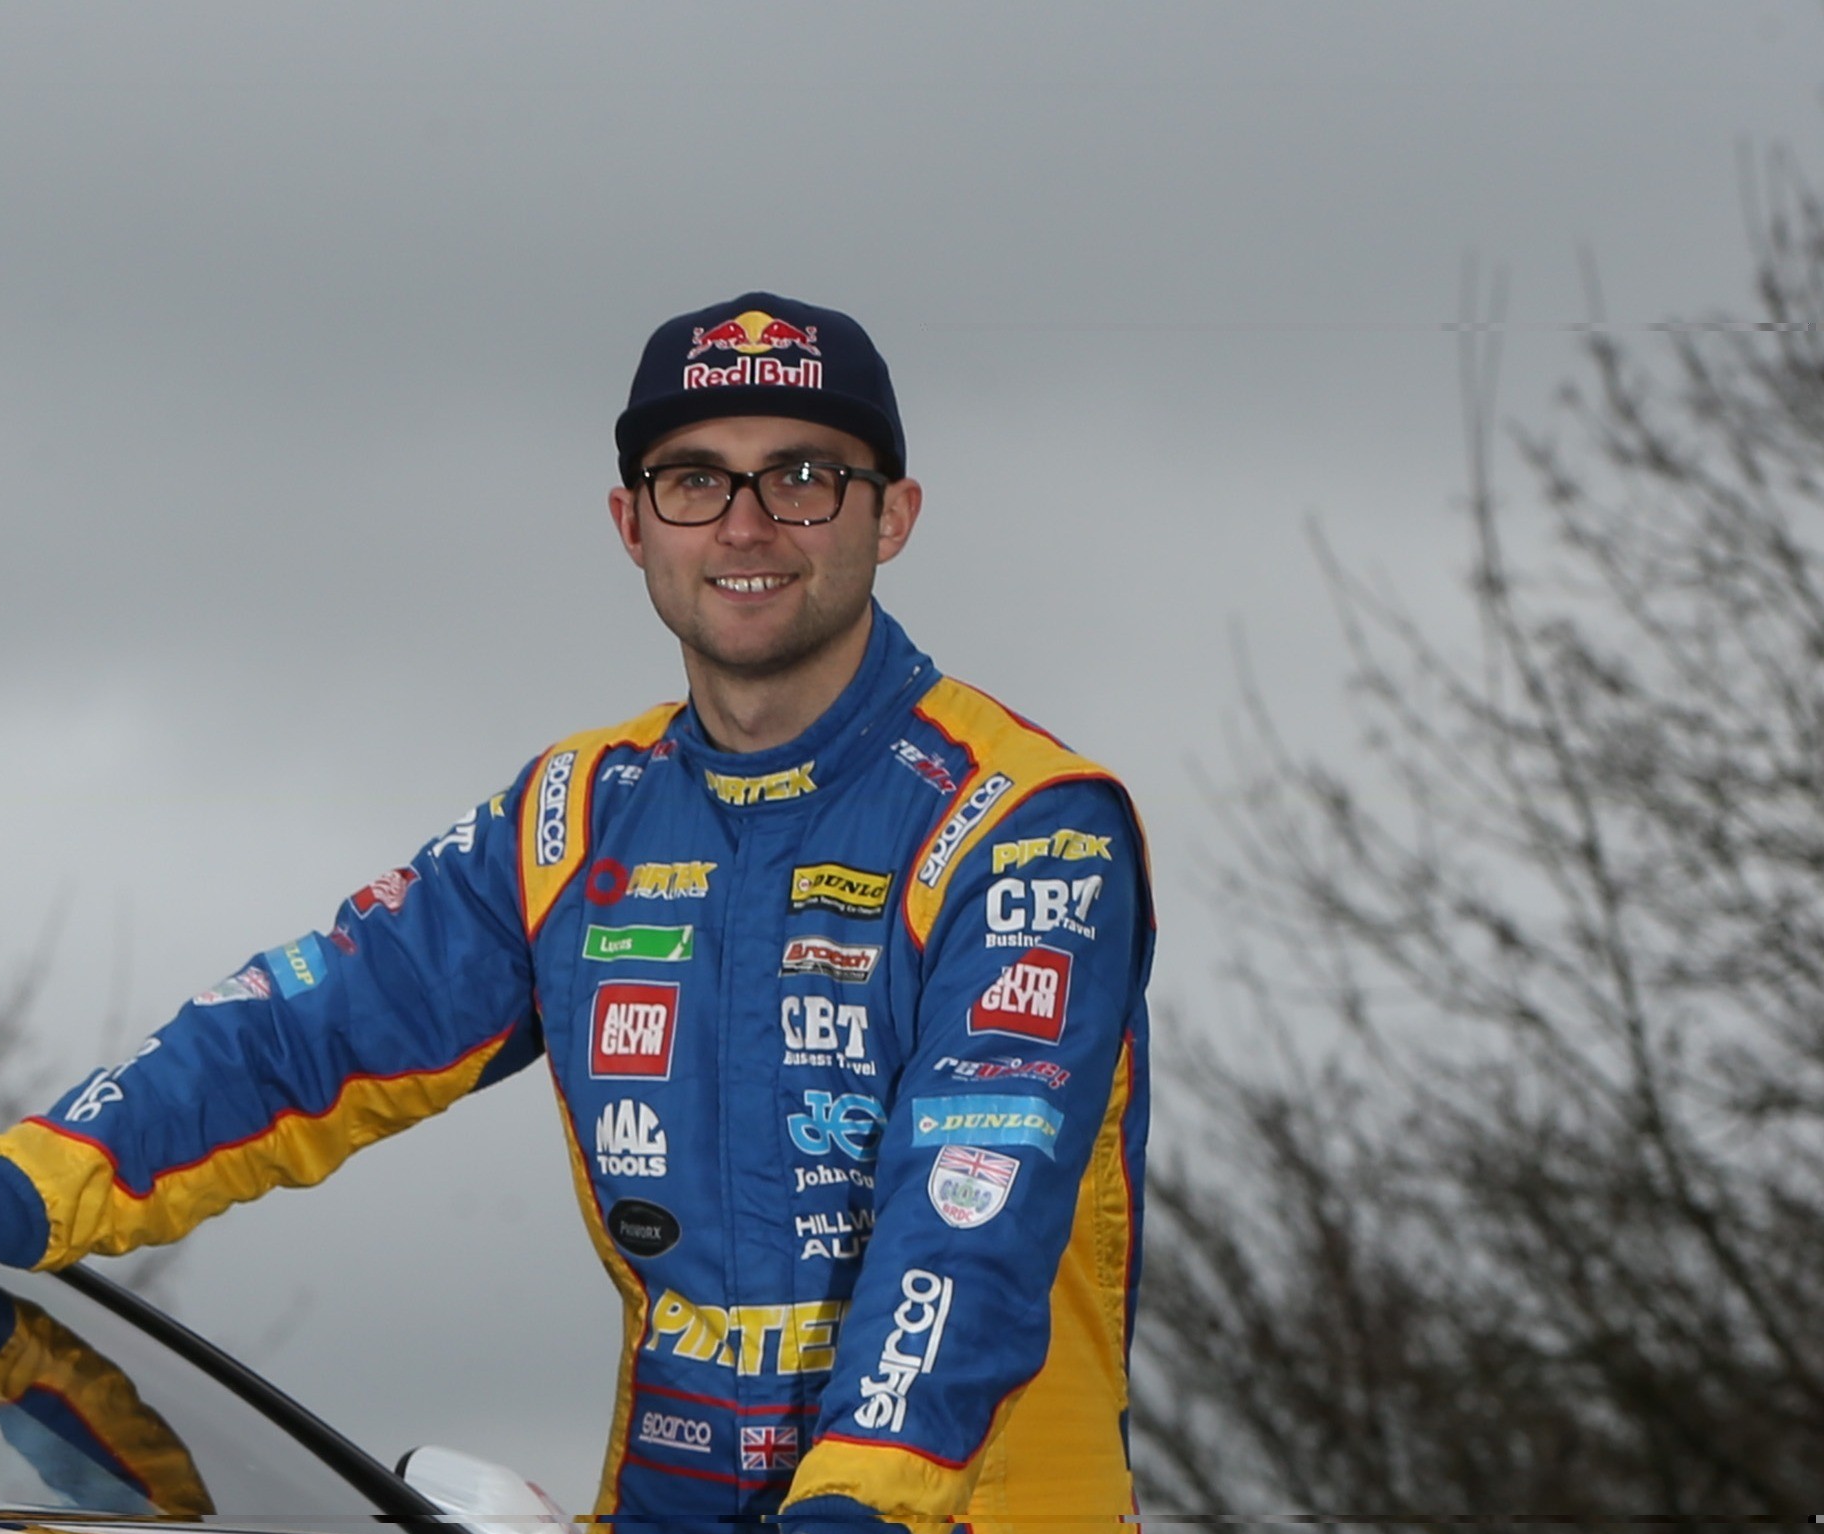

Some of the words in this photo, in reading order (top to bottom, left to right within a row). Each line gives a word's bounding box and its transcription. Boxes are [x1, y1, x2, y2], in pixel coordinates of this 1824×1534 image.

[684, 357, 750, 389] Red
[755, 358, 823, 389] Bull
[536, 752, 573, 866] sparco
[918, 775, 1013, 887] sparco
[813, 874, 885, 898] DUNLO
[985, 875, 1103, 932] CBT
[604, 1003, 668, 1031] AUTO
[980, 984, 1056, 1019] GLYM
[600, 1027, 664, 1056] GLYM
[781, 995, 869, 1058] CBT
[596, 1099, 668, 1154] MAC
[597, 1155, 667, 1178] TOOLS
[794, 1165, 848, 1193] John
[646, 1287, 850, 1376] PIRTE
[639, 1411, 712, 1453] sparco
